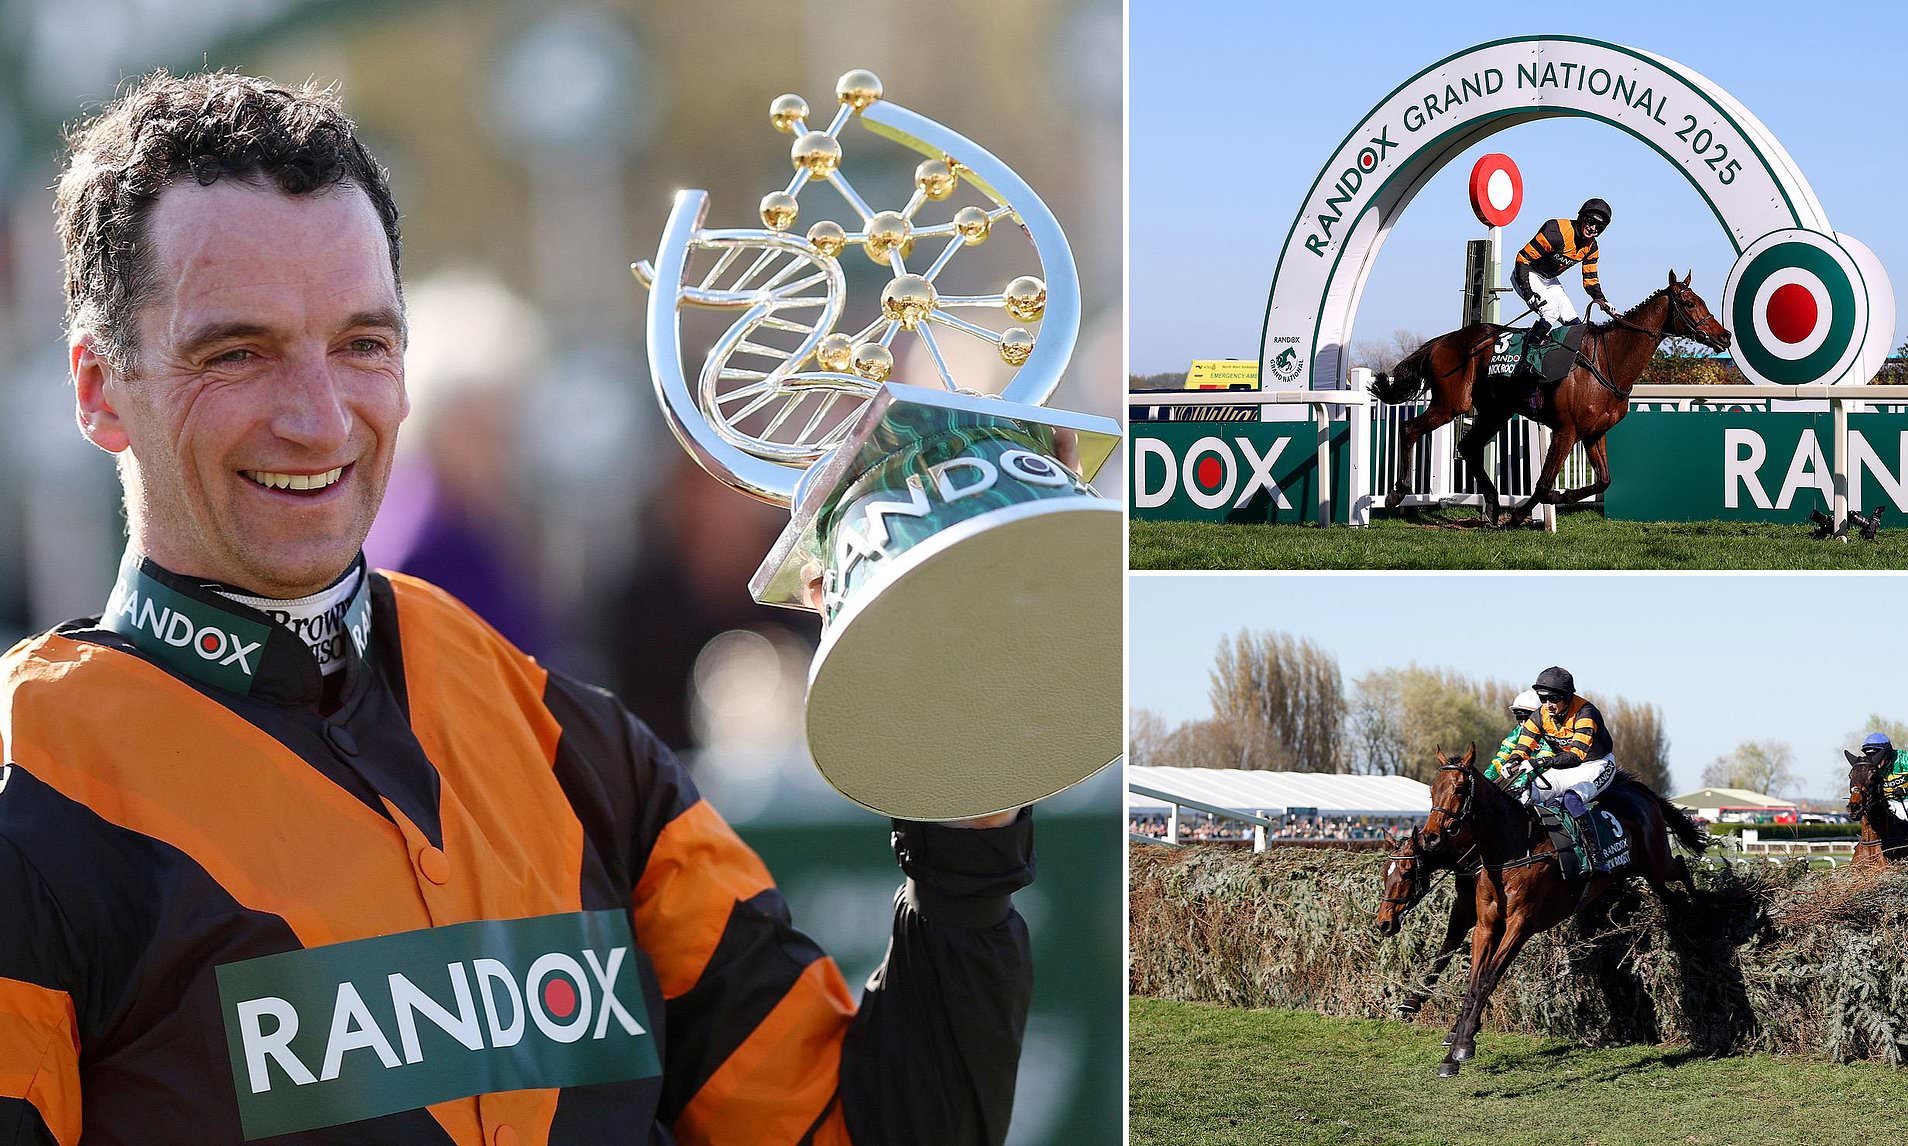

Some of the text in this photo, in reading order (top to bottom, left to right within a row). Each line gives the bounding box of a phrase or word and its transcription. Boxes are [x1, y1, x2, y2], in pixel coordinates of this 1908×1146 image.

[1304, 62, 1743, 258] RANDOX GRAND NATIONAL 2025
[1273, 336, 1300, 344] RANDOX
[1495, 331, 1514, 354] 3
[1270, 359, 1304, 383] GRAND NATIONAL
[1134, 436, 1293, 510] DOX
[1724, 428, 1908, 515] RAN
[1600, 810, 1624, 838] 3
[236, 946, 647, 1094] RANDOX
